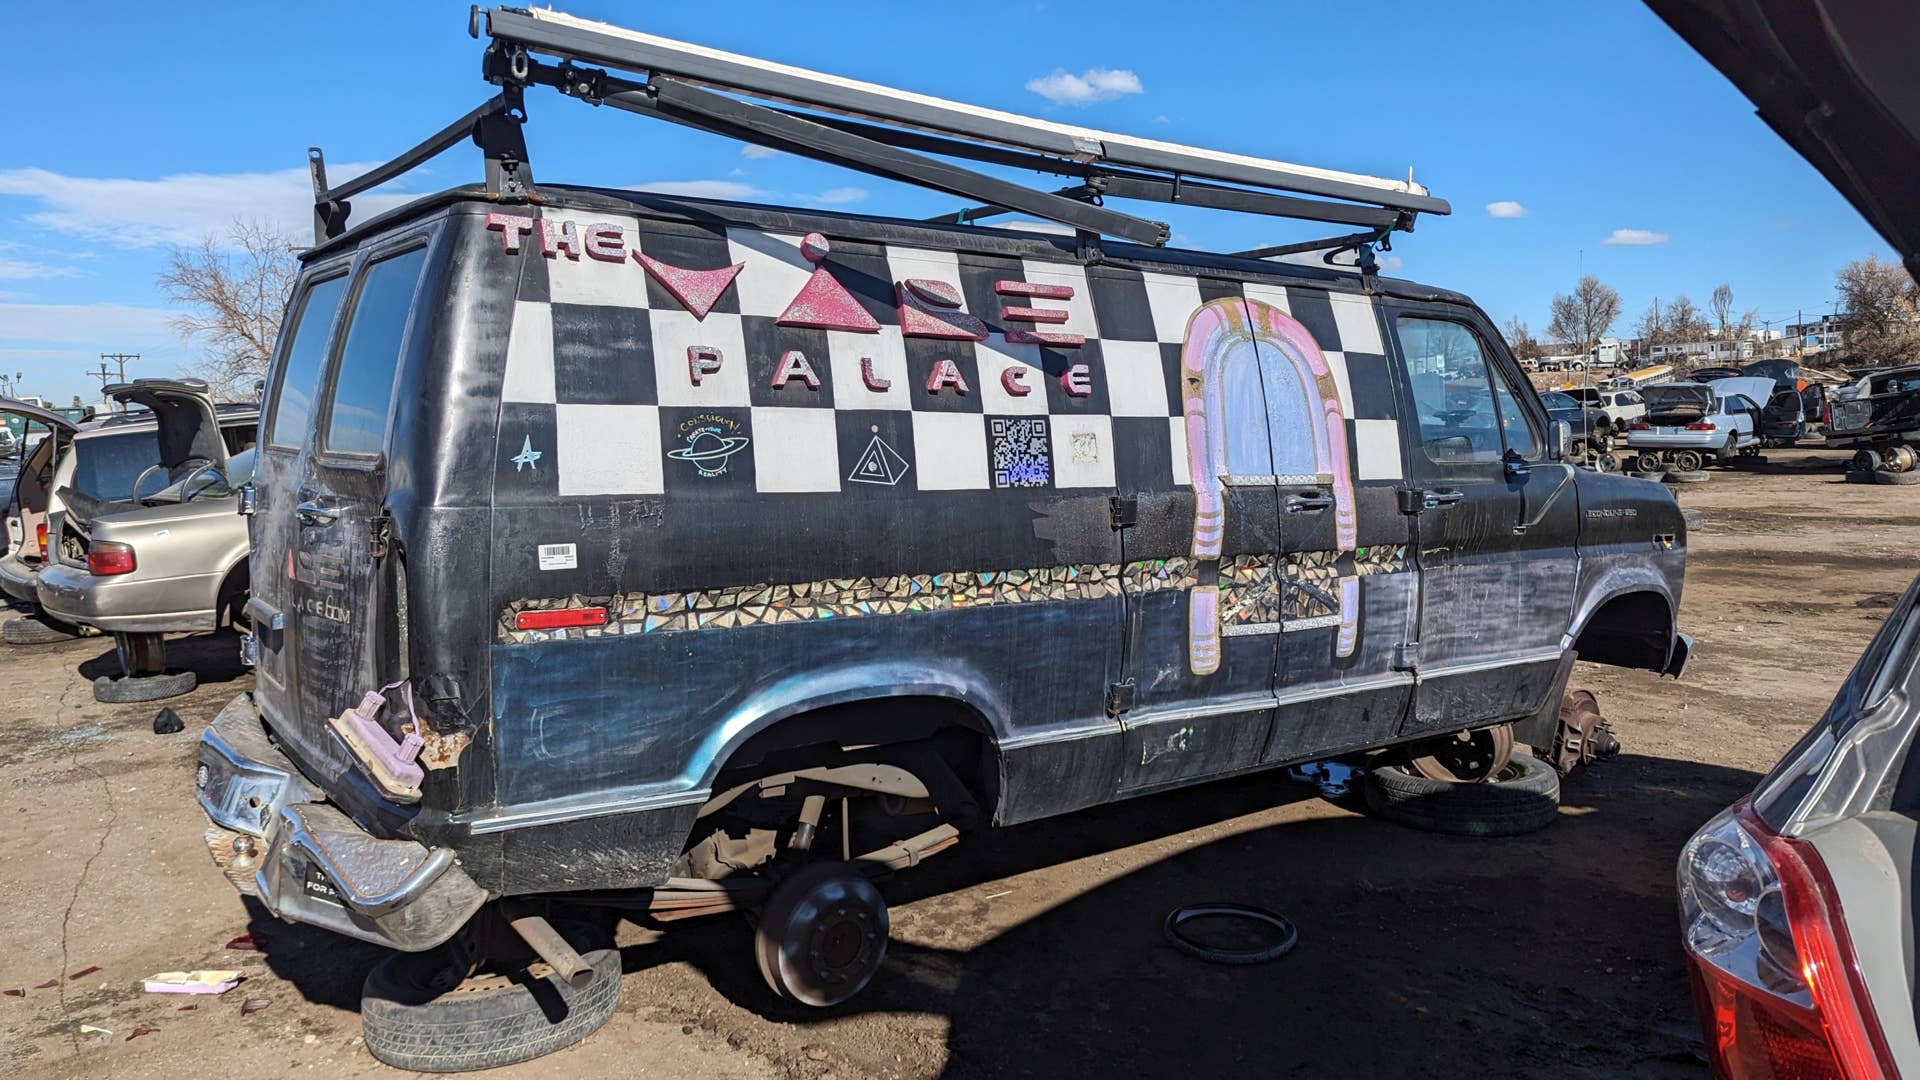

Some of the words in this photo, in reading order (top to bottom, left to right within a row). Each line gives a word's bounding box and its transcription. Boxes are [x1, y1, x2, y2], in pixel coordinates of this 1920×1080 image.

[486, 212, 627, 264] THE
[687, 344, 1093, 398] PALACE
[698, 467, 728, 478] REALITY
[307, 881, 328, 893] FOR
